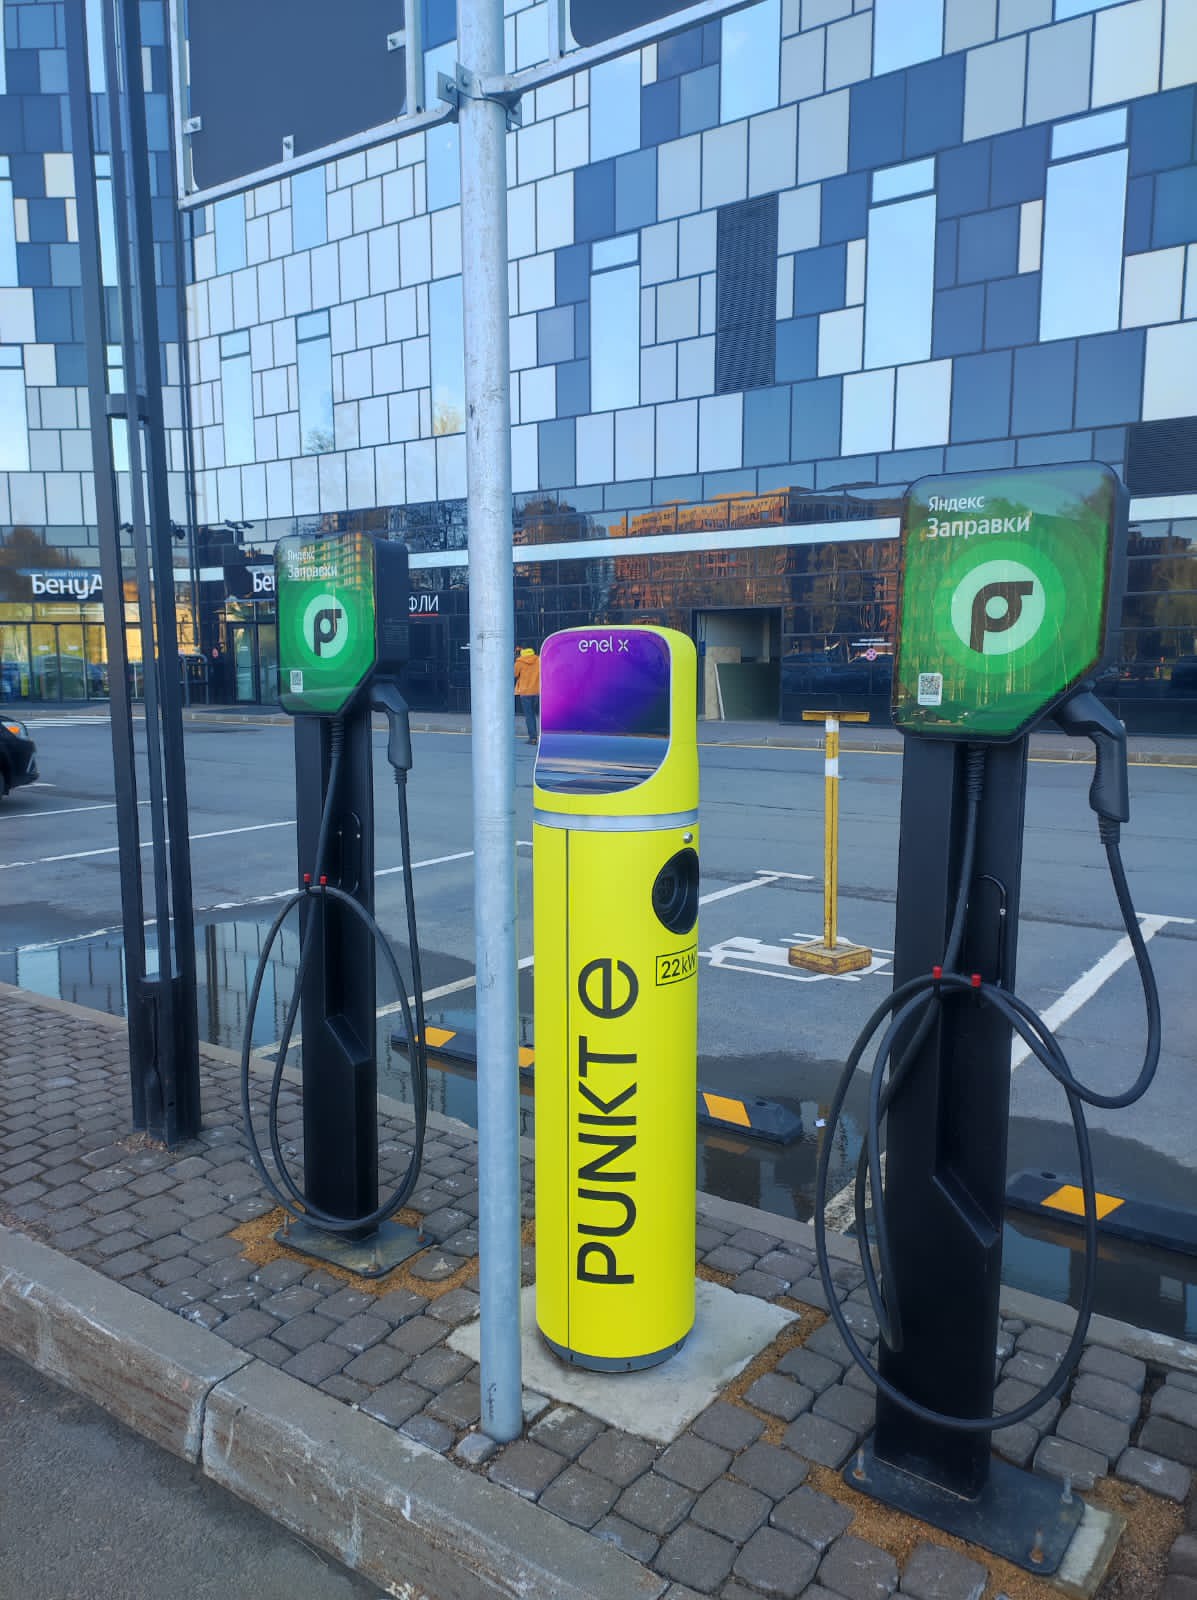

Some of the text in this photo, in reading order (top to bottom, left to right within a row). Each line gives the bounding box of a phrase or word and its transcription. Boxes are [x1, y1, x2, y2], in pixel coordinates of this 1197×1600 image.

[928, 496, 985, 512] Яндекс
[927, 517, 1031, 540] Заправки
[287, 564, 338, 579] Заправки
[30, 573, 103, 600] БенуА
[578, 634, 629, 653] enel x
[661, 951, 697, 979] 22kW
[577, 1035, 637, 1285] PUNKT
